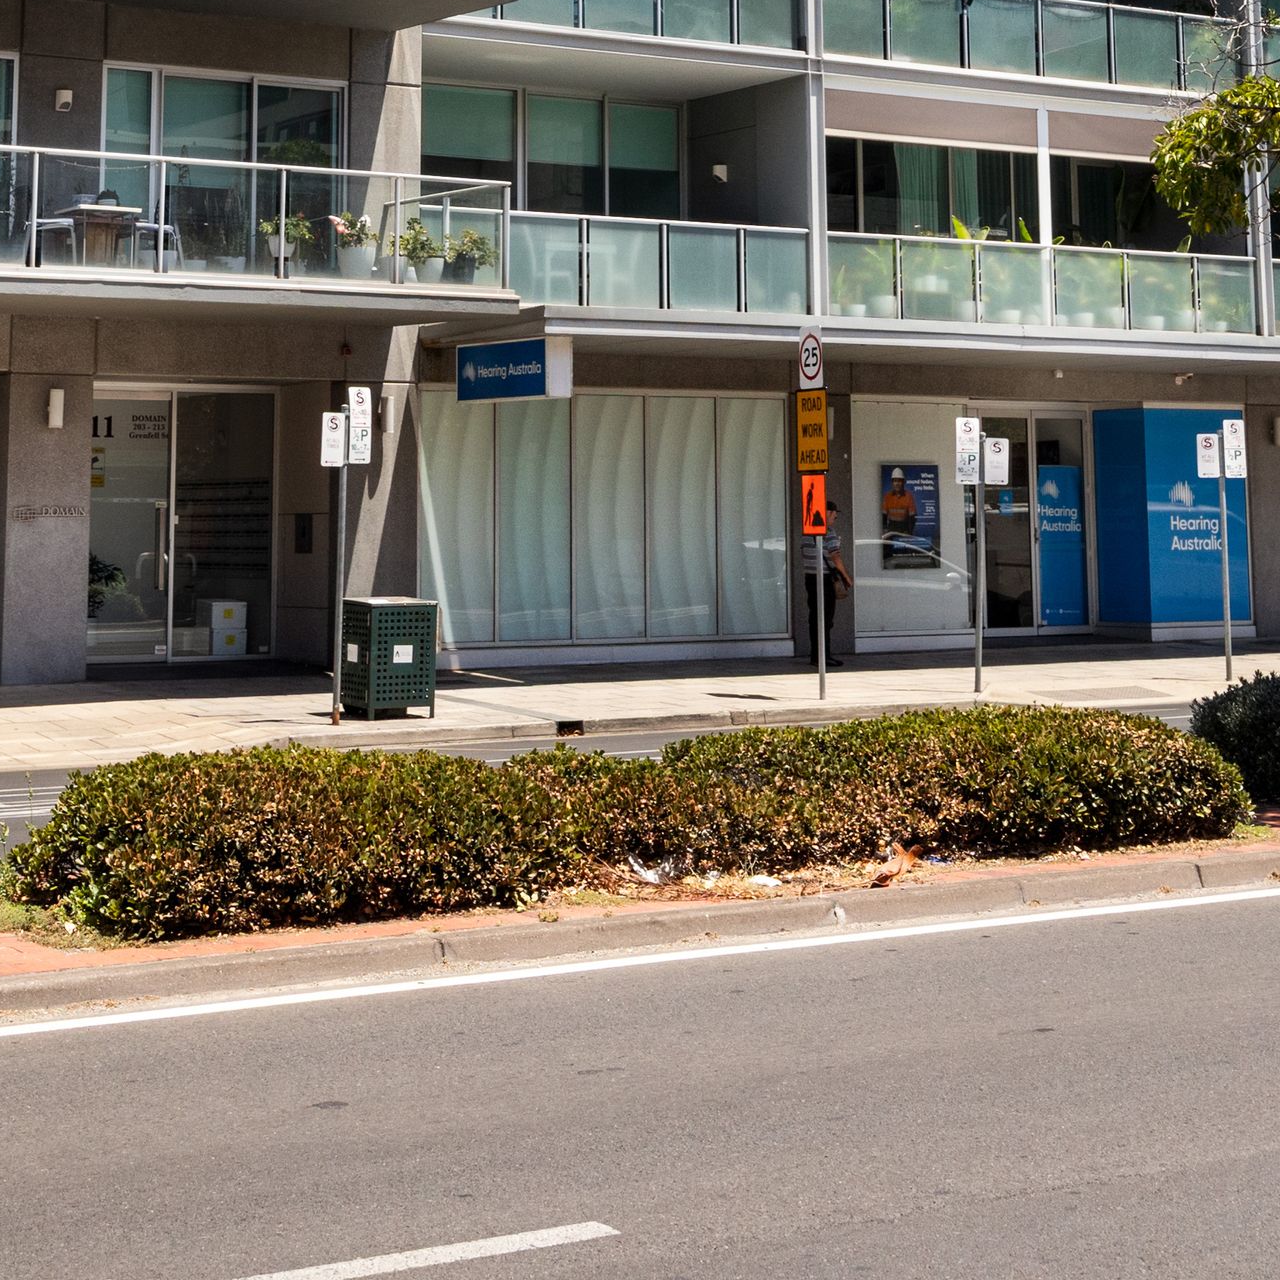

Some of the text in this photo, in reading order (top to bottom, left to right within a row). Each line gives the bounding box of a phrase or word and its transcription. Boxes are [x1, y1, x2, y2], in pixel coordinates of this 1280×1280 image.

[803, 347, 818, 367] 25
[478, 361, 542, 379] Hearing Australia
[801, 397, 822, 412] ROAD
[801, 424, 824, 438] WORK
[800, 449, 826, 464] AHEAD
[42, 506, 86, 517] DOMAIN
[1041, 505, 1078, 520] Hearing
[1041, 520, 1082, 532] Australia
[1170, 515, 1219, 534] Hearing
